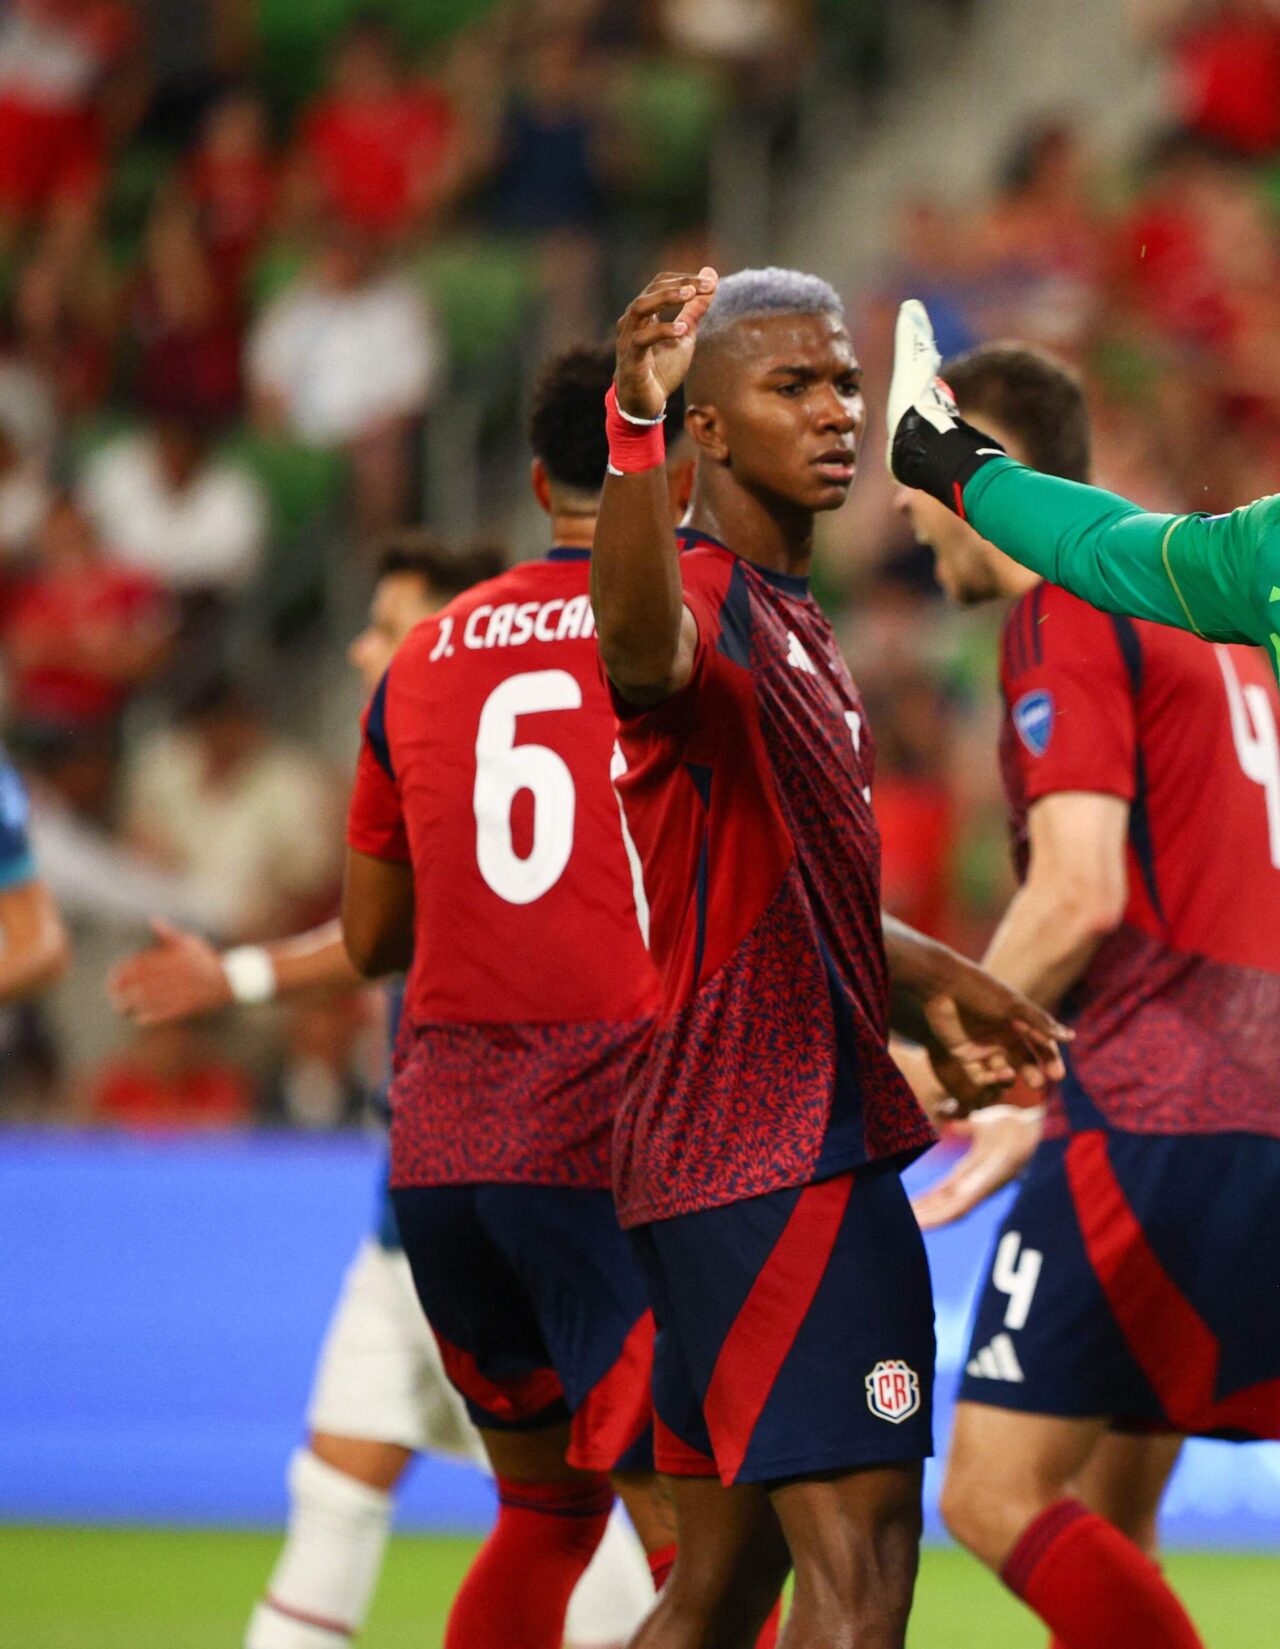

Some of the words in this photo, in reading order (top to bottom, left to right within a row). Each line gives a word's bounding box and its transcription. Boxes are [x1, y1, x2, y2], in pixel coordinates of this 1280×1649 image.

[429, 615, 455, 662] J.
[473, 668, 582, 905] 6
[992, 1230, 1044, 1331] 4
[878, 1373, 907, 1410] CR
